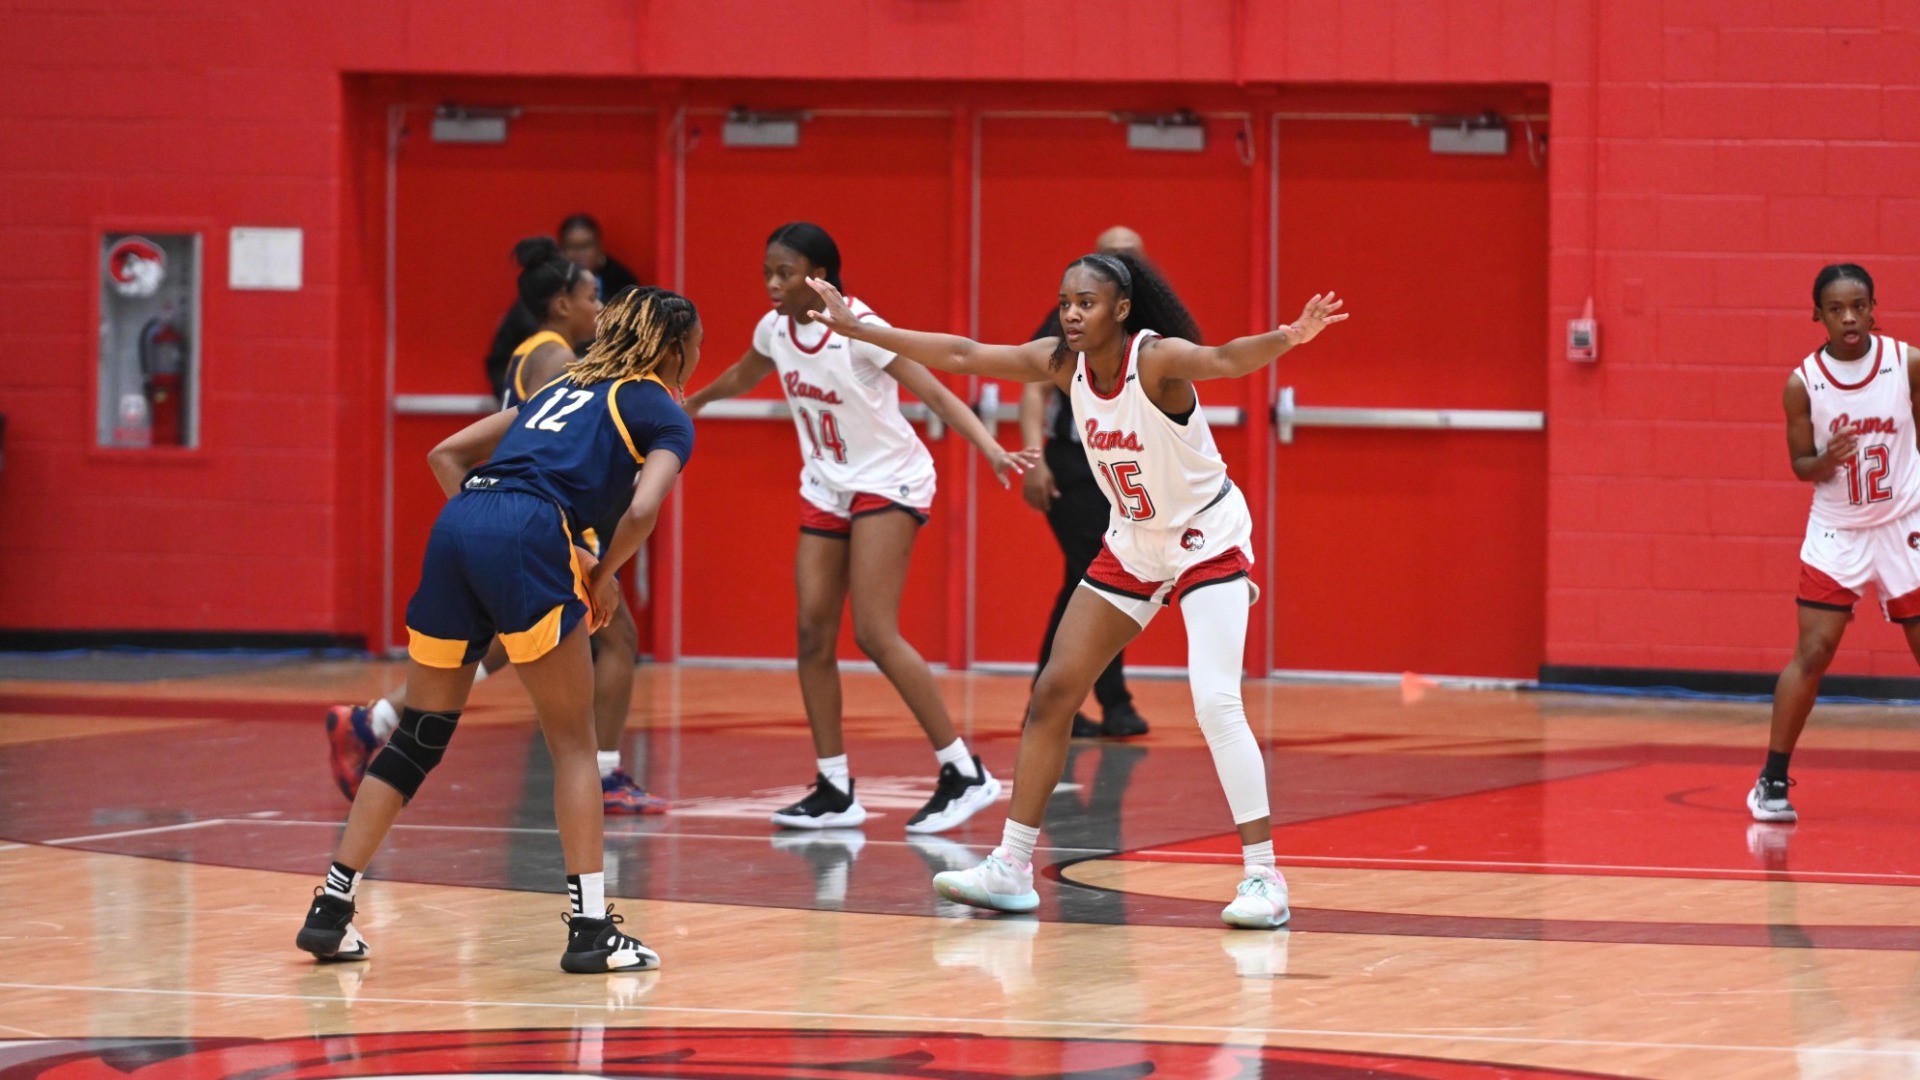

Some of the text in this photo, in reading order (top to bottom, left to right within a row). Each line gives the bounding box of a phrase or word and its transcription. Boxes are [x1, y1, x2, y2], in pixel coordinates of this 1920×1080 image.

[525, 387, 595, 433] 12
[784, 370, 843, 405] Rams
[799, 407, 848, 464] 14
[1086, 418, 1144, 452] Rams
[1098, 460, 1156, 521] 15
[1843, 443, 1892, 505] 12
